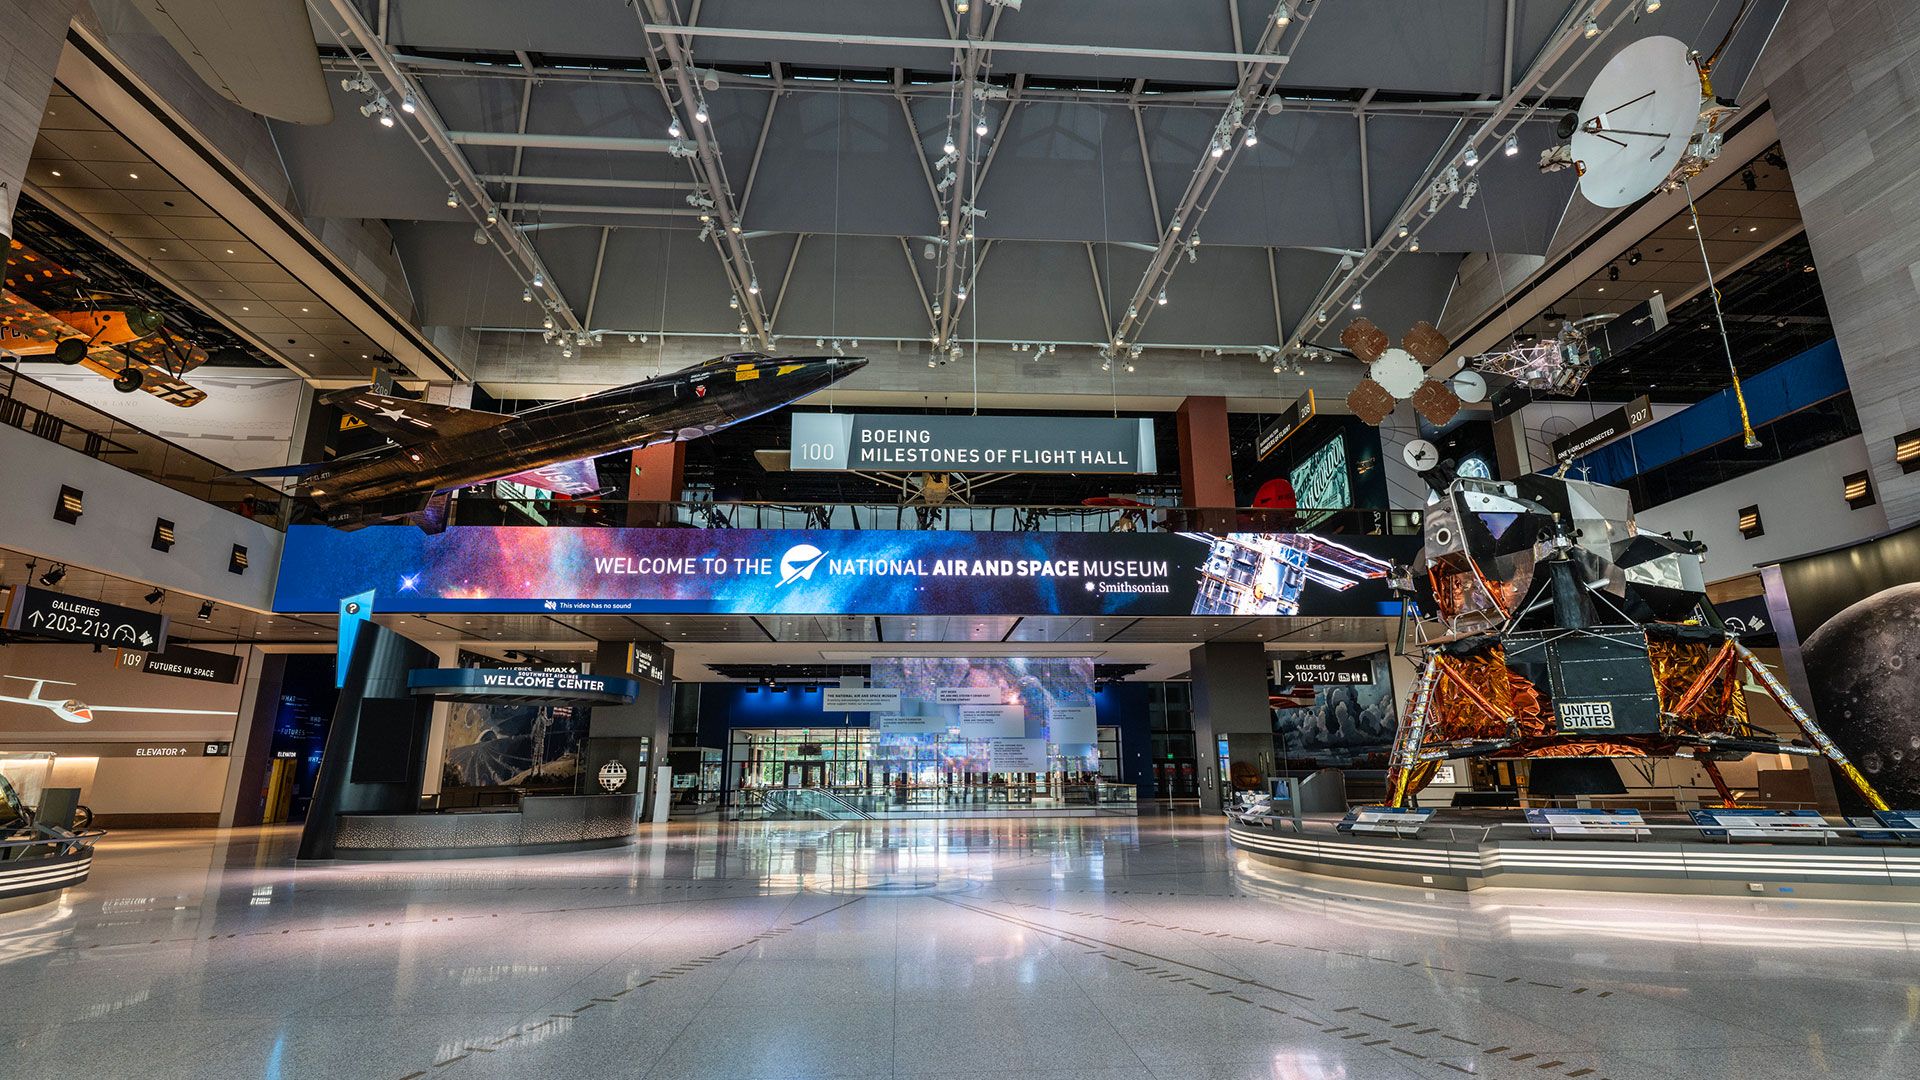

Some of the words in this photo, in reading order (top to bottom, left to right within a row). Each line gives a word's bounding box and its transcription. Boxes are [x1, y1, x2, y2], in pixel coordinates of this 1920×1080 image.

[1630, 408, 1648, 424] 207
[861, 429, 930, 444] BOEING
[1557, 450, 1568, 460] ONE
[1584, 427, 1615, 447] CONNECTED
[801, 443, 834, 461] 100
[861, 447, 980, 463] MILESTONES
[984, 449, 1007, 463] OF
[1011, 449, 1077, 464] FLIGHT
[1081, 450, 1129, 465] HALL
[594, 557, 697, 575] WELCOME
[702, 558, 727, 575] TO
[733, 558, 772, 575] THE
[829, 559, 928, 576] NATIONAL
[932, 560, 968, 576] AIR
[971, 560, 1014, 577] AND
[1016, 560, 1079, 577] SPACE
[1083, 561, 1168, 577] MUSEUM
[1098, 581, 1169, 593] Smithsonian
[51, 600, 100, 617] GALLERIES
[45, 612, 110, 639] 203-213
[122, 653, 142, 667] 109
[149, 661, 182, 673] FUTURES
[184, 666, 192, 675] IN
[193, 668, 215, 678] SPACE
[1296, 671, 1336, 682] 102-107
[483, 674, 555, 688] WELCOME
[557, 678, 605, 692] CENTER
[1561, 704, 1610, 716] UNITED
[1563, 715, 1612, 727] STATES
[136, 748, 178, 756] ELEVATOR
